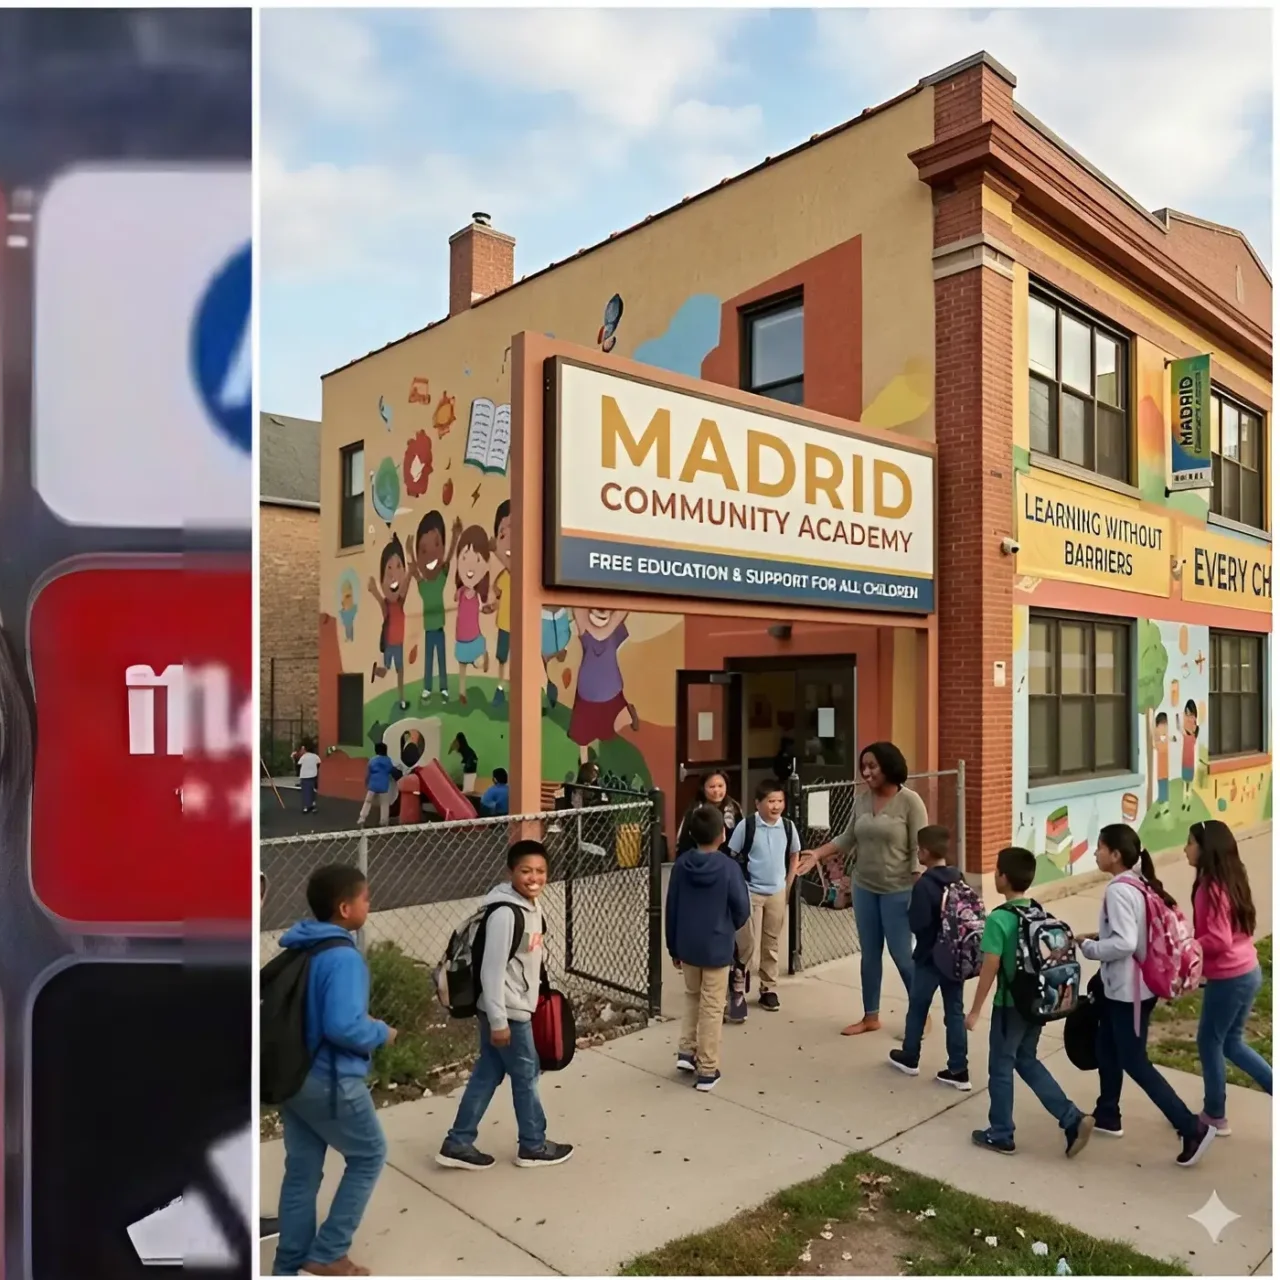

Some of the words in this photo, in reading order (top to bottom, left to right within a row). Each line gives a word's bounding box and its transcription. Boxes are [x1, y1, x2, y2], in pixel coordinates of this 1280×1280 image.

[1179, 376, 1193, 446] MADRID
[601, 394, 913, 520] MADRID
[601, 482, 790, 535] COMMUNITY
[798, 515, 913, 553] ACADEMY
[1025, 493, 1101, 537] LEARNING
[1105, 515, 1163, 550] WITHOUT
[590, 552, 632, 572] FREE
[638, 557, 728, 582] EDUCATION
[732, 567, 742, 582] &
[746, 569, 809, 589] SUPPORT
[811, 576, 836, 592] FOR
[839, 579, 861, 594] ALL
[863, 582, 918, 599] CHILDREN
[1065, 540, 1133, 576] BARRIERS
[1195, 547, 1248, 593] EVERY
[1252, 562, 1272, 598] CH
